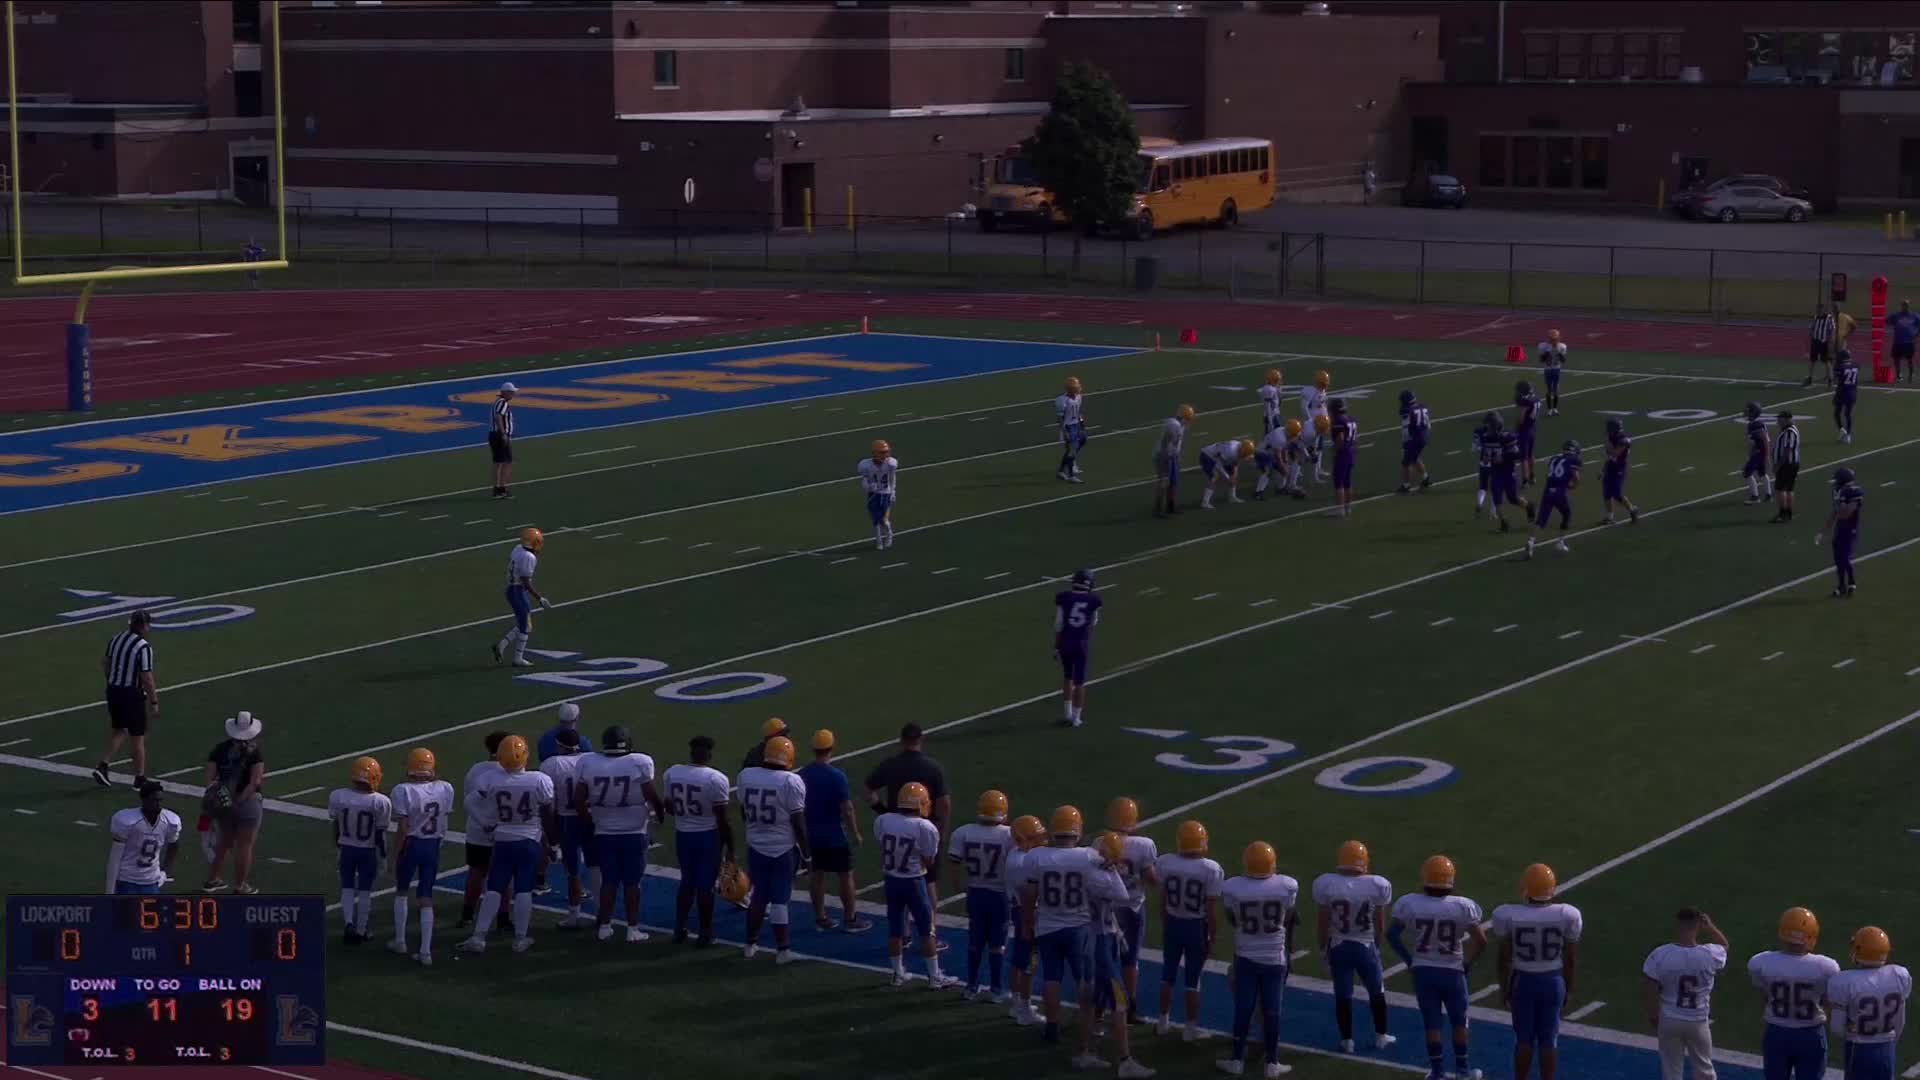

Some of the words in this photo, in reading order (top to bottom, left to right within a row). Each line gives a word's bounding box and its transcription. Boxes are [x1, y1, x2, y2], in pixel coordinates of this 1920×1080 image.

[1068, 601, 1088, 628] 5
[512, 655, 790, 703] 20
[1154, 735, 1459, 794] 30
[497, 790, 532, 823] 64
[594, 775, 630, 808] 77
[670, 783, 702, 817] 65
[744, 788, 777, 825] 55
[341, 807, 374, 841] 10
[421, 801, 440, 836] 3
[137, 839, 158, 868] 9
[882, 834, 916, 874] 87
[963, 842, 1001, 879] 57
[1043, 870, 1083, 909] 68
[1165, 875, 1201, 912] 89
[1240, 901, 1282, 936] 59
[1330, 900, 1371, 934] 34
[1415, 918, 1457, 955] 79
[1515, 926, 1562, 962] 56
[1676, 975, 1699, 1010] 6
[1770, 981, 1815, 1021] 85
[1857, 993, 1902, 1036] 22
